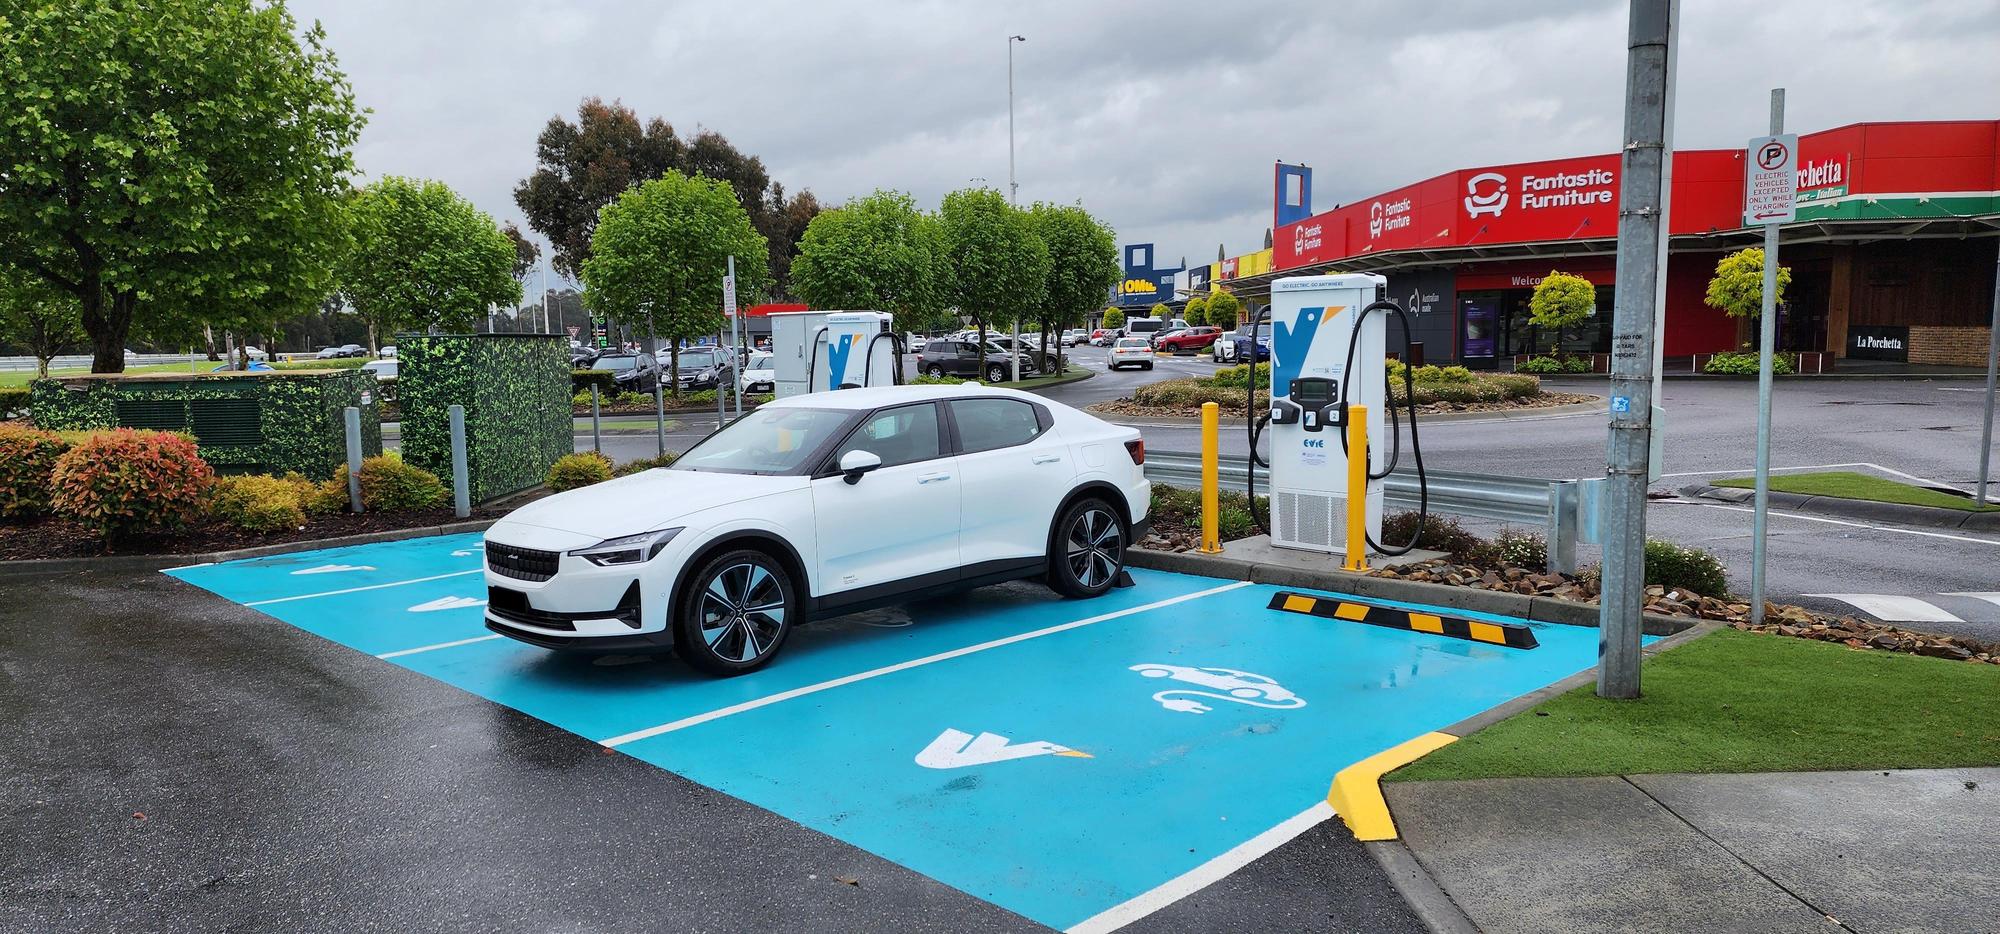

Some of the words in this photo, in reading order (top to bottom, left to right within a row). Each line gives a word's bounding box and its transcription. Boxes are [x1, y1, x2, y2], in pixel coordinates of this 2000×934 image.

[1522, 169, 1613, 192] Fantastic
[1755, 171, 1789, 180] ELECTRIC
[1796, 159, 1842, 188] rchetta
[1755, 179, 1789, 187] VEHICLES
[1753, 187, 1790, 196] EXCEPTED
[1521, 189, 1613, 210] Furniture
[1749, 196, 1769, 204] ONLY
[1772, 194, 1793, 202] WHILE
[1385, 198, 1411, 217] Fantastic
[1752, 202, 1789, 211] CHARGING
[1385, 214, 1411, 231] Furniture
[1305, 224, 1322, 238] Fantastic
[1512, 276, 1545, 286] Welco
[1857, 335, 1866, 348] La
[1867, 335, 1902, 350] Porchetta
